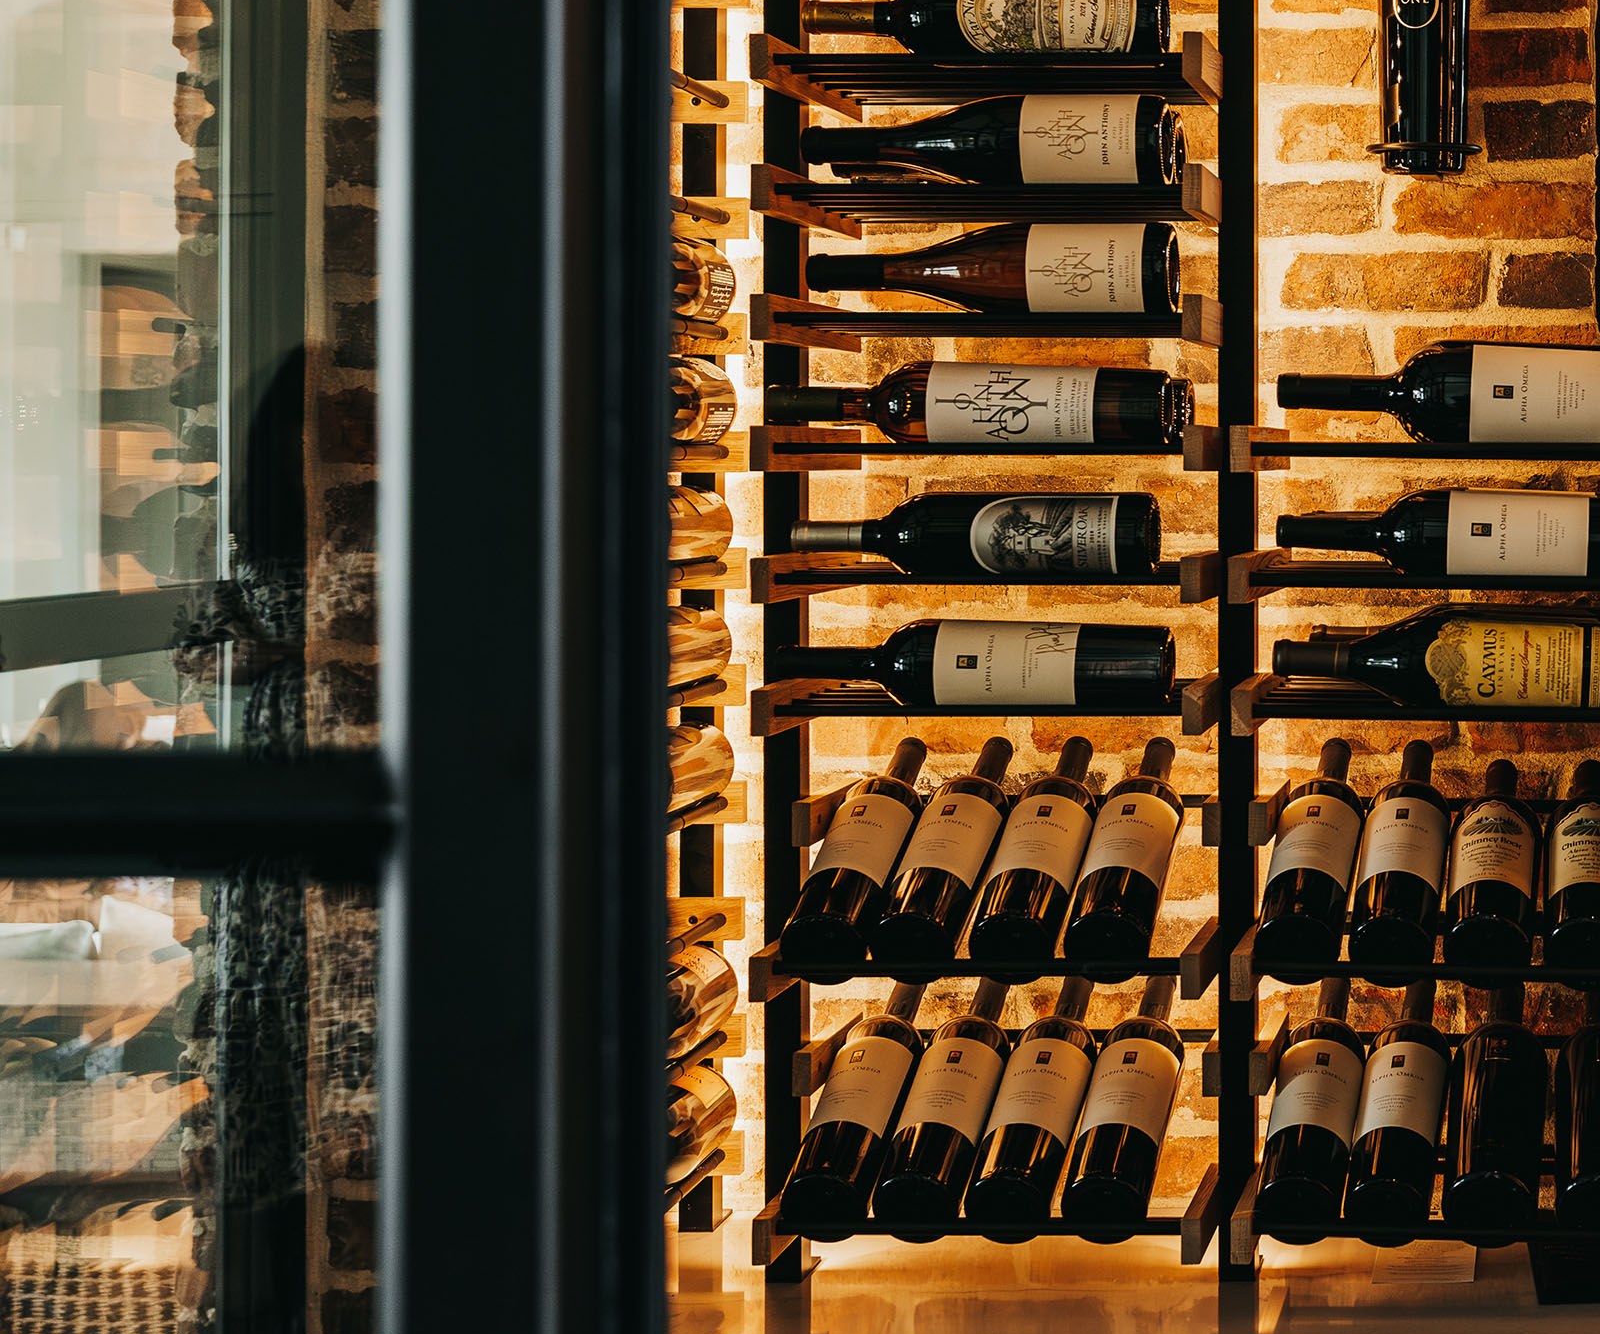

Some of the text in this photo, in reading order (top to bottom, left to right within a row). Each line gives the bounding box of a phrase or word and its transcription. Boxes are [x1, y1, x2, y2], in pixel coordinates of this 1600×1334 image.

[966, 19, 985, 39] Far
[1084, 12, 1099, 44] Cabernet
[1101, 103, 1110, 165] JOHN ANTHONY
[1107, 238, 1117, 303] JOHN ANTHONY
[1520, 365, 1529, 393] OMEGA
[1054, 376, 1064, 437] JOHN ANTHONY
[1076, 506, 1089, 567] SILVER OAK
[985, 634, 995, 693] ALPHA OMEGA
[1477, 629, 1498, 698] CAYMUS
[1497, 630, 1505, 694] VINEYARDS
[1516, 629, 1534, 700] Cabernet Sauvignon
[943, 818, 973, 829] OMEGA
[1040, 819, 1069, 833] OMEGA
[1125, 817, 1155, 829] OMEGA
[1401, 822, 1429, 834] OMEGA
[1461, 836, 1499, 851] Chimney
[1561, 839, 1600, 851] Chimney
[1039, 1067, 1067, 1081] OMEGA
[1126, 1067, 1155, 1080] OMEGA
[1395, 1071, 1425, 1082] OMEGA
